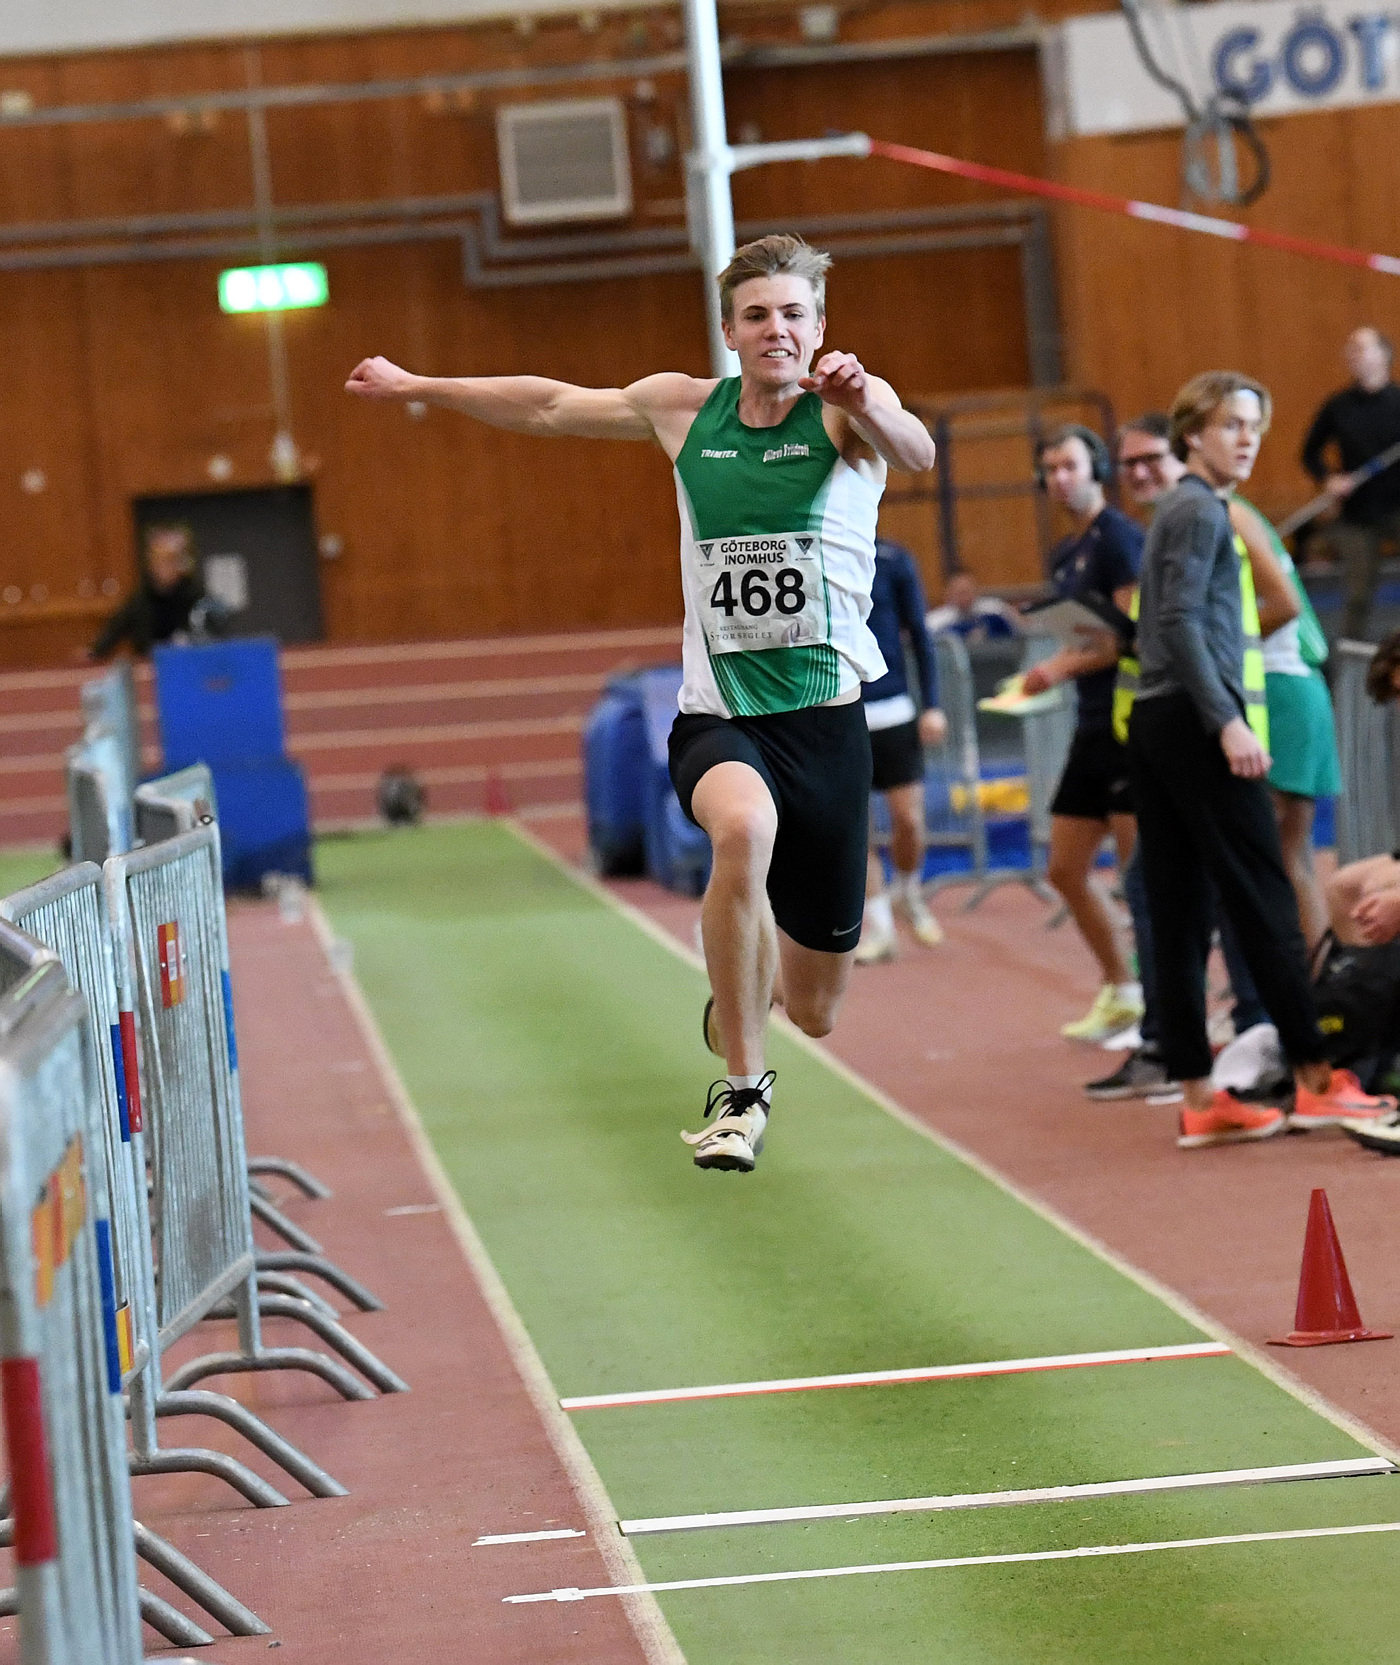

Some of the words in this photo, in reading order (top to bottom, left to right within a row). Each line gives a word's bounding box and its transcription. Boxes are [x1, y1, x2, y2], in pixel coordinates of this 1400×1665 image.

[701, 449, 738, 459] TRIMTEX
[720, 540, 787, 553] GÖTEBORG
[724, 552, 785, 566] INOMHUS
[710, 568, 806, 617] 468
[710, 631, 773, 641] STORSEGLET
